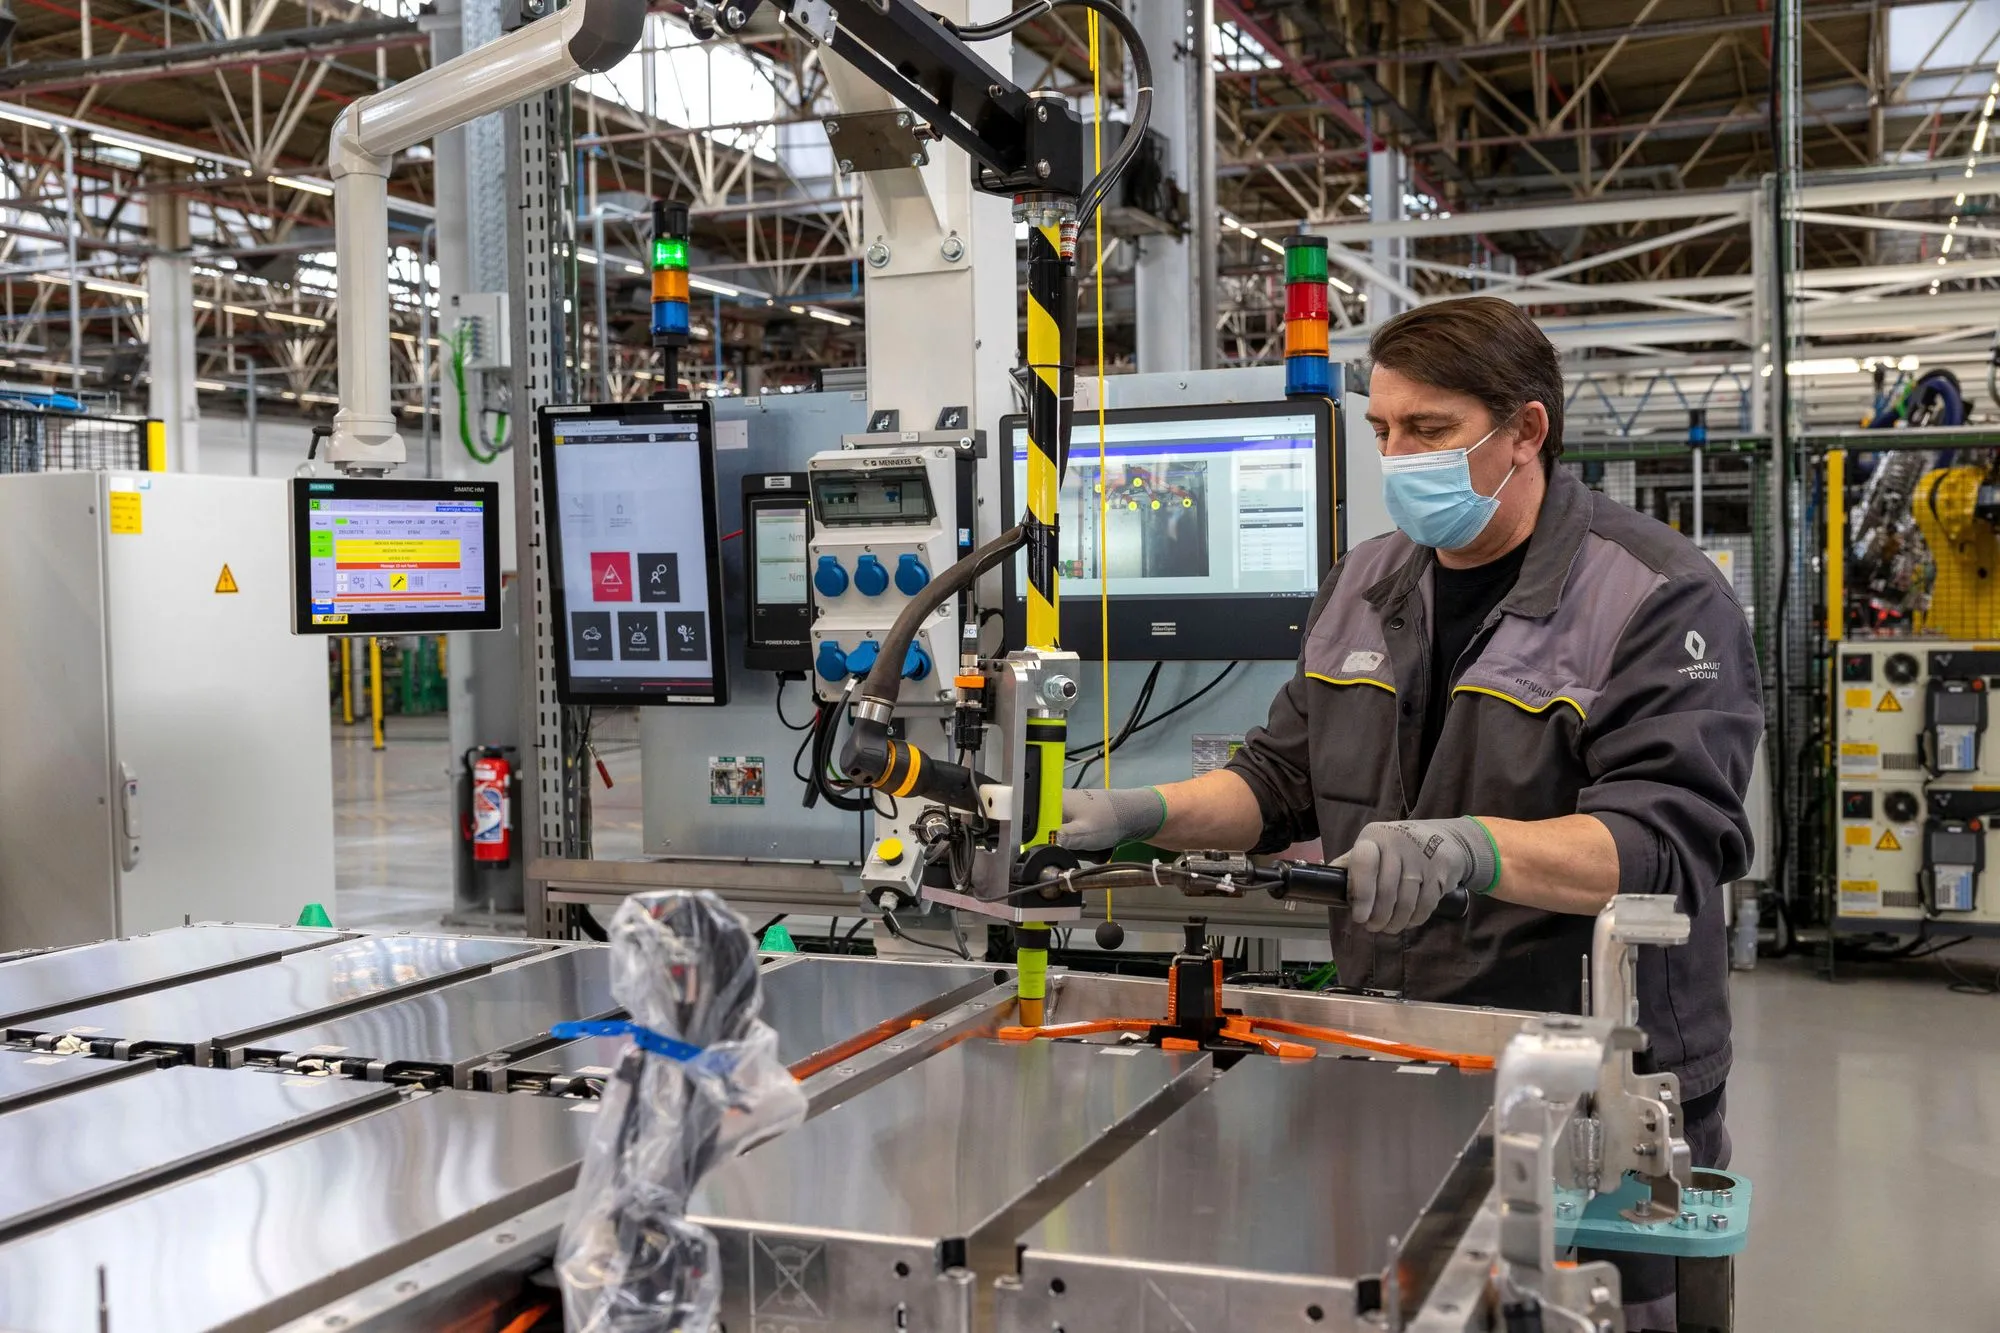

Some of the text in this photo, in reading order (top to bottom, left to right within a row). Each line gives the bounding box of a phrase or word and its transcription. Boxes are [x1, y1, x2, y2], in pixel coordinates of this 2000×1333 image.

[878, 458, 912, 467] MENNEKES
[788, 533, 804, 542] Nm
[788, 573, 805, 582] Nm
[1689, 671, 1718, 680] DOUAI
[1515, 677, 1557, 698] RENAUL
